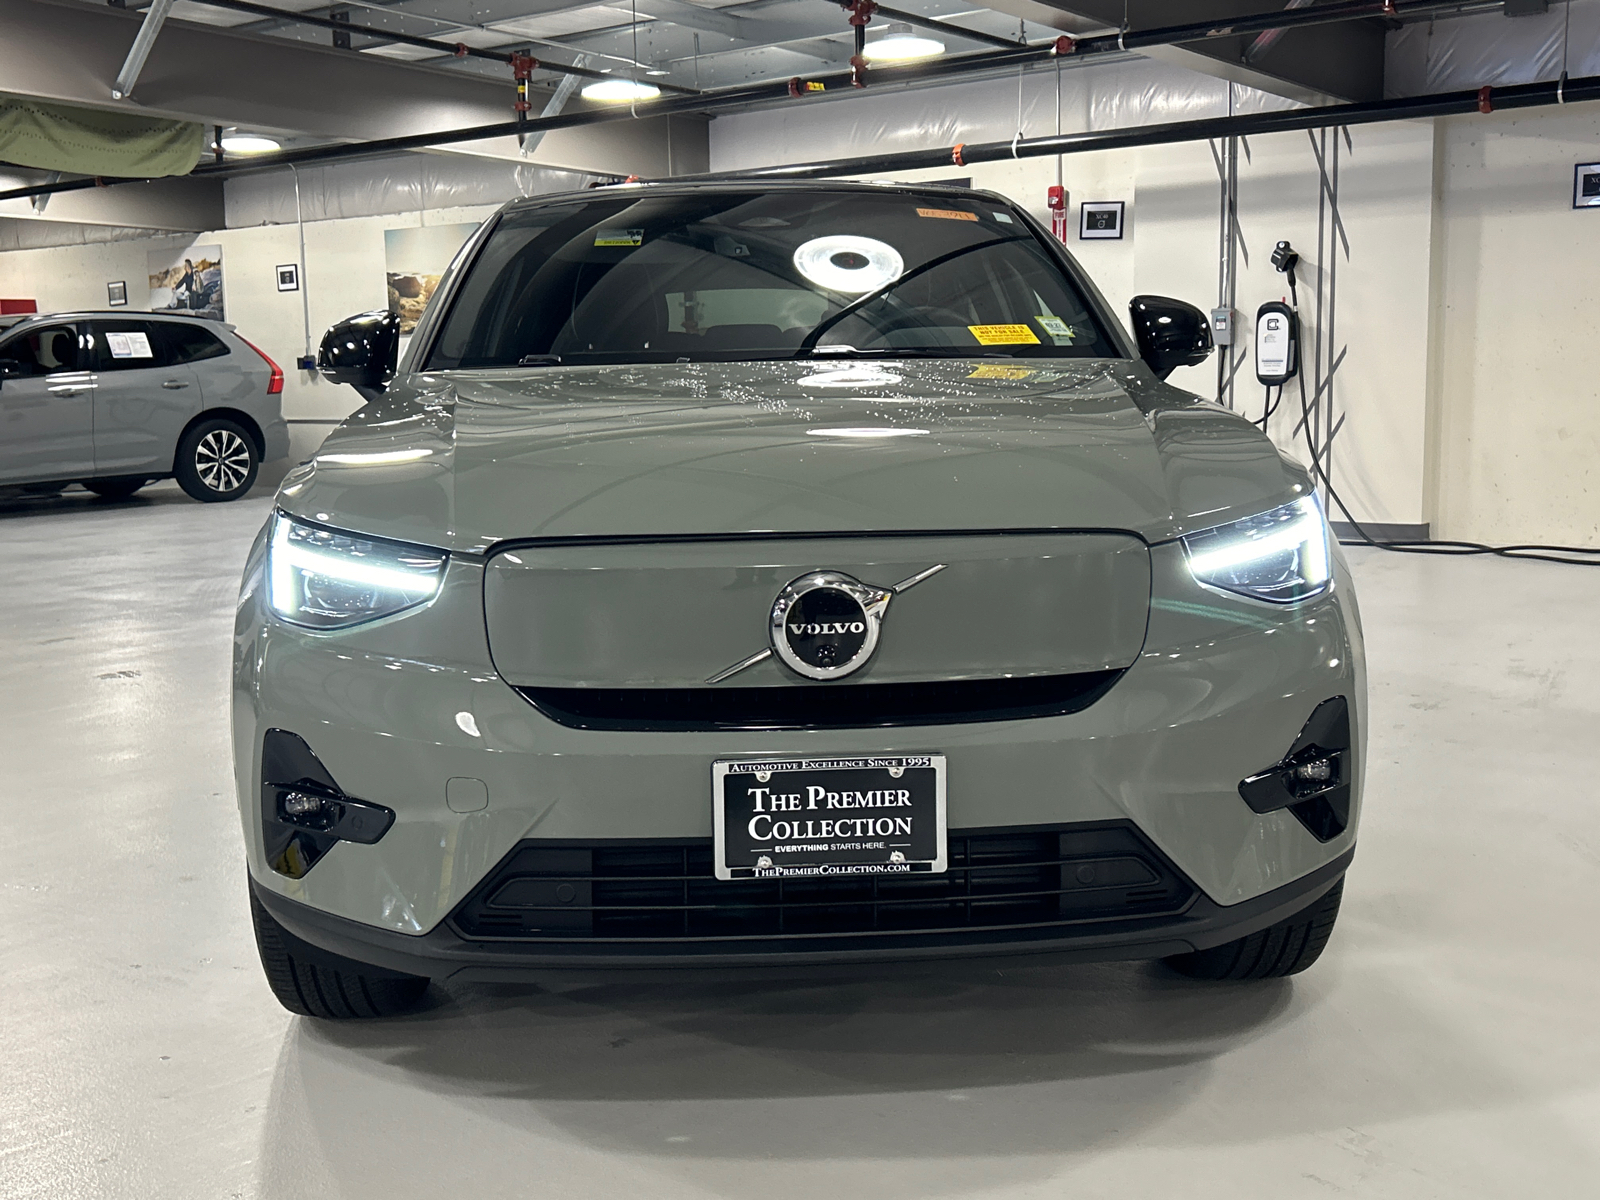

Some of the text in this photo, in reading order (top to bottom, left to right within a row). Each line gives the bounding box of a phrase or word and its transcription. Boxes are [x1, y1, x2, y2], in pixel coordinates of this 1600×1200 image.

[788, 622, 864, 635] VOLVO
[731, 757, 930, 773] AUTOMOTIVE EXCELLENCE SINCE 1995
[748, 785, 912, 812] THE PREMIER
[748, 815, 913, 841] COLLECTION
[774, 844, 828, 852] EVERYTHING
[862, 842, 886, 850] HERE.
